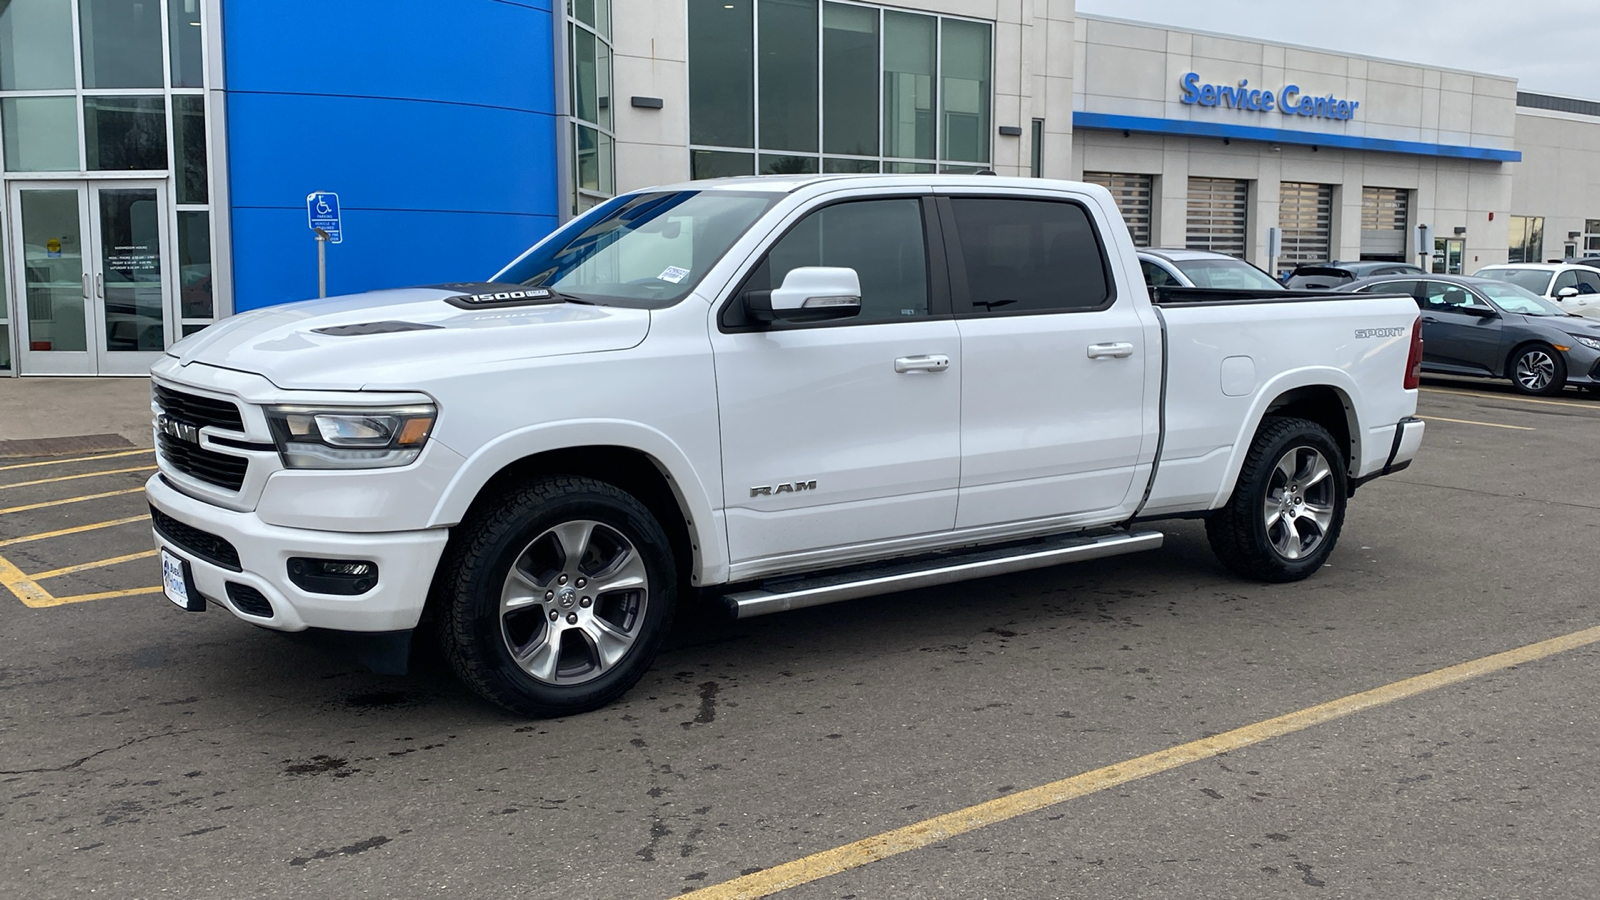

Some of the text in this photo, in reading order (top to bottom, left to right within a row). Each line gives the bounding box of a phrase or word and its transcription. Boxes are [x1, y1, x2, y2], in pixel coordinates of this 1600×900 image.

[1180, 72, 1360, 120] Service Center
[470, 290, 526, 302] 1500
[1354, 326, 1406, 340] SPORT
[158, 416, 198, 445] RAM
[750, 479, 818, 498] RAM
